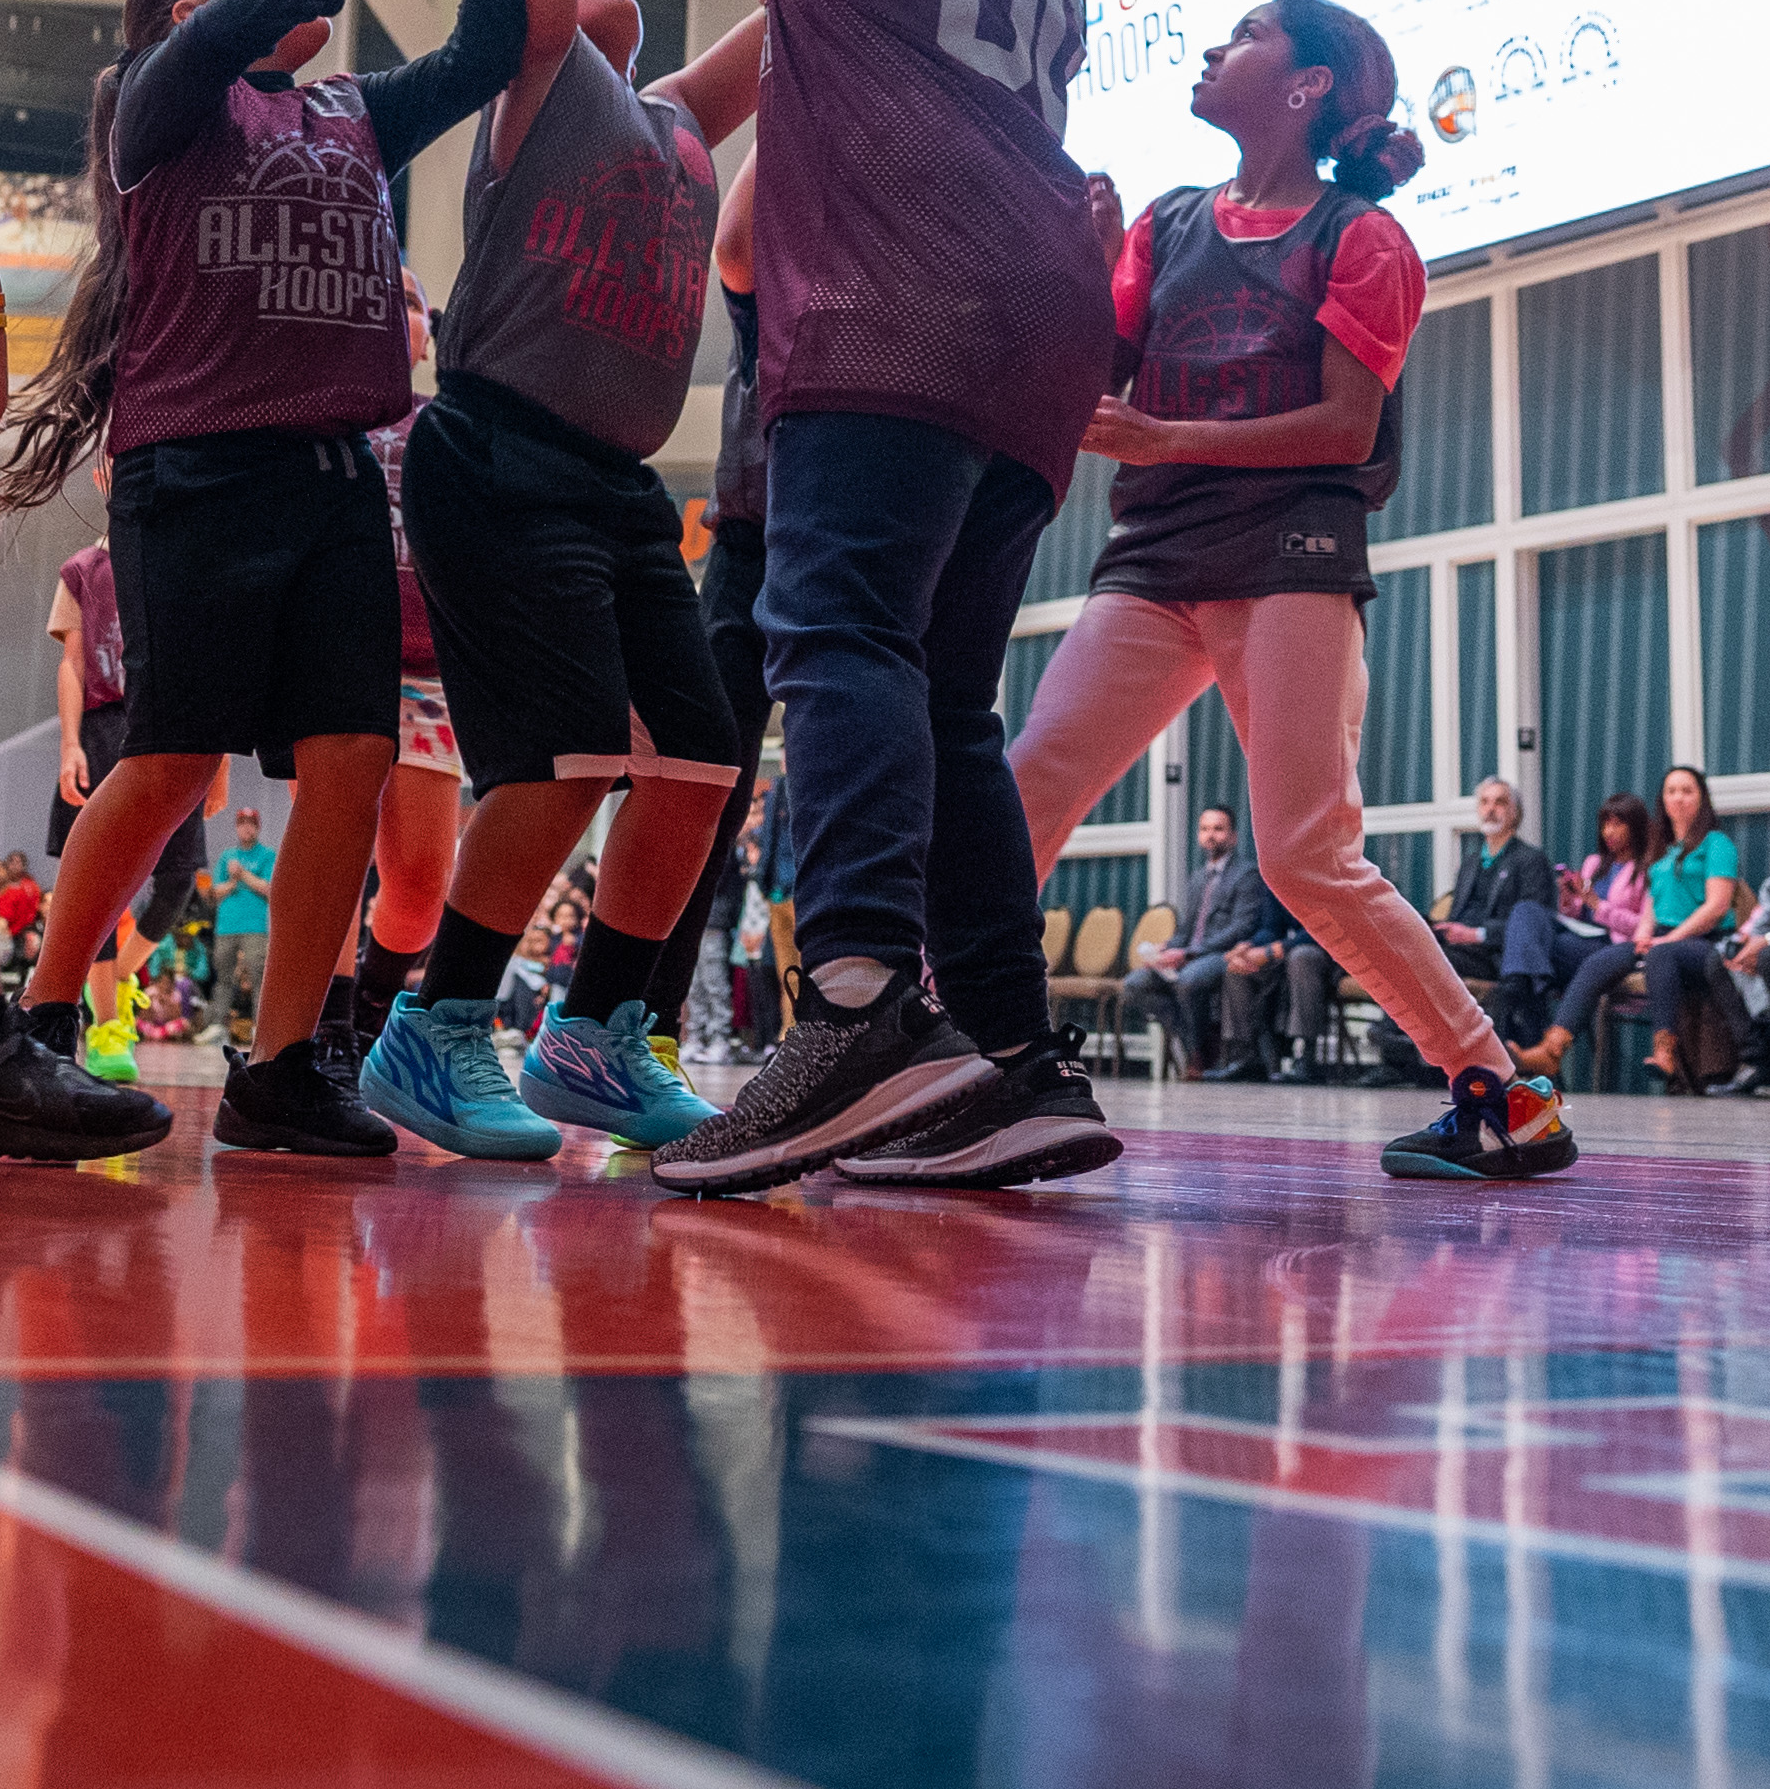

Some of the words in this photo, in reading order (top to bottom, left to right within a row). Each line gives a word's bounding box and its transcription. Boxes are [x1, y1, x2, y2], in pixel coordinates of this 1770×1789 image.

[1077, 3, 1185, 100] HOOPS
[258, 266, 388, 321] HOOPS
[564, 267, 689, 360] HOOPS
